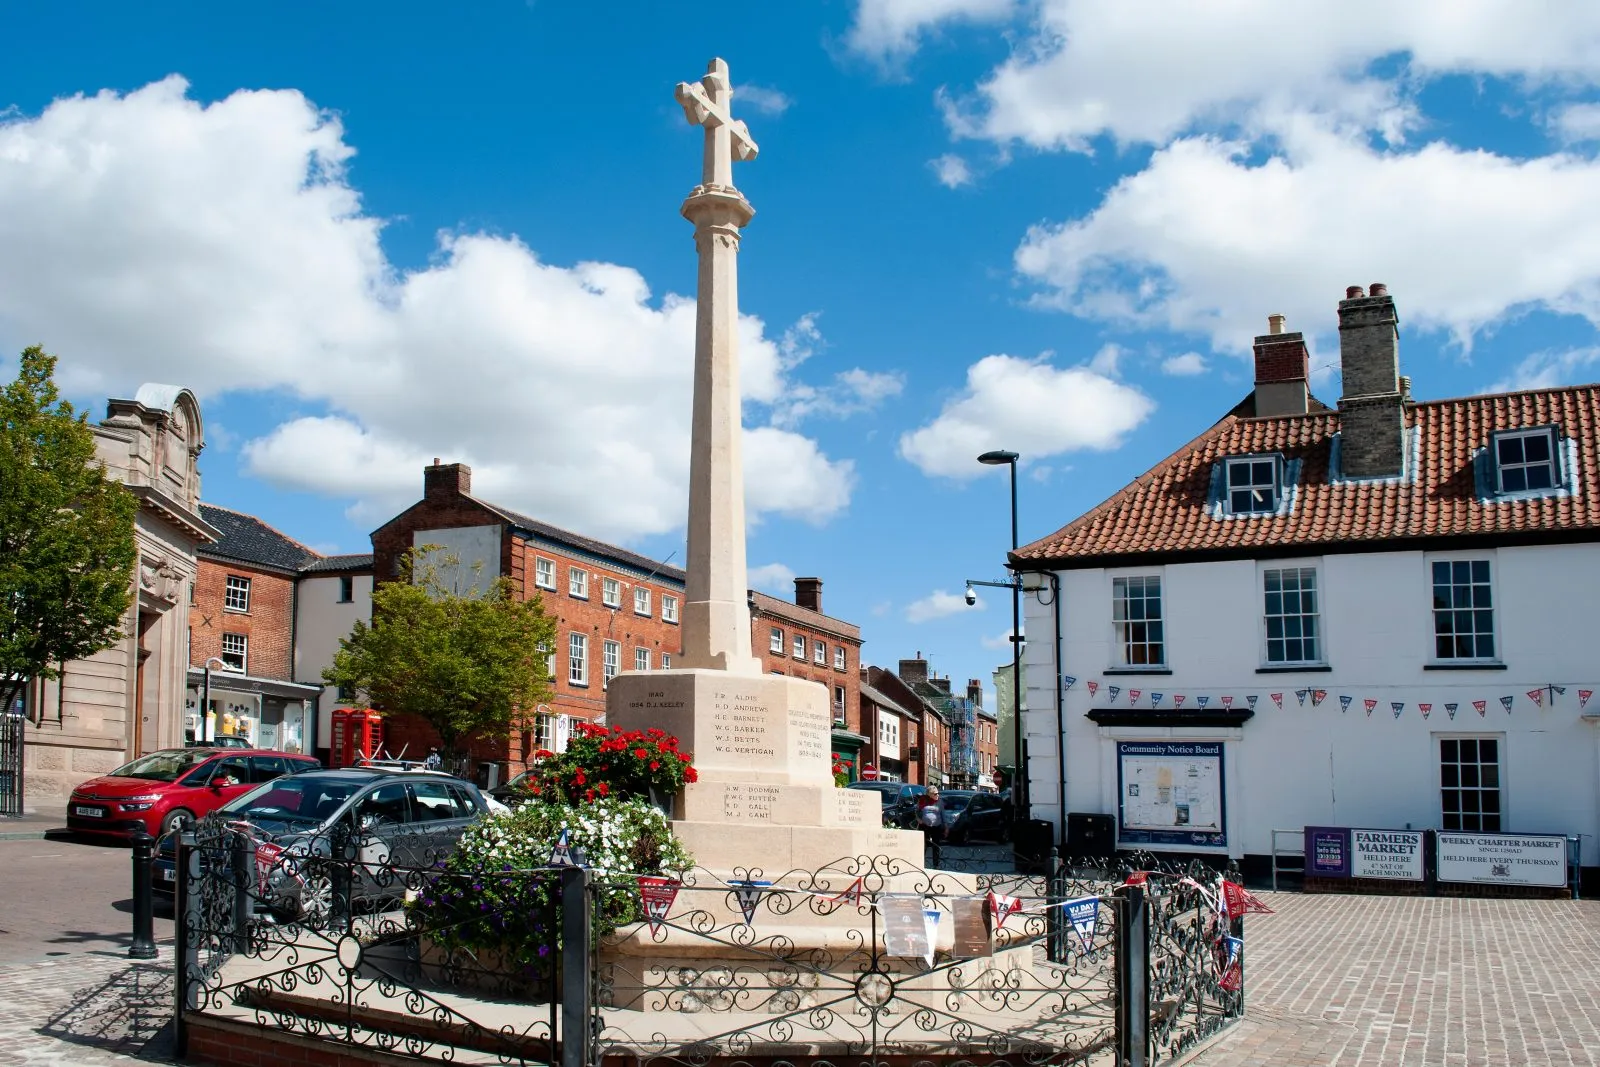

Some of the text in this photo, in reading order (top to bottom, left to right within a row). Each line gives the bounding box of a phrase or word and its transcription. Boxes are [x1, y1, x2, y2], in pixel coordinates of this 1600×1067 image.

[734, 705, 769, 713] ANDREWS
[734, 725, 766, 733] BARKER
[734, 747, 774, 756] VERTIGAN
[1120, 745, 1219, 755] Community Notice Board
[748, 786, 780, 794] DODMAN
[1355, 833, 1419, 844] FARMERS
[1441, 837, 1561, 849] WEEKLY CHARTER MARKET
[1358, 843, 1417, 854] MARKET
[1363, 854, 1411, 863] HELD HERE
[1515, 858, 1560, 866] THURSDAY
[998, 902, 1009, 911] 75
[1069, 902, 1095, 913] VJ DAY
